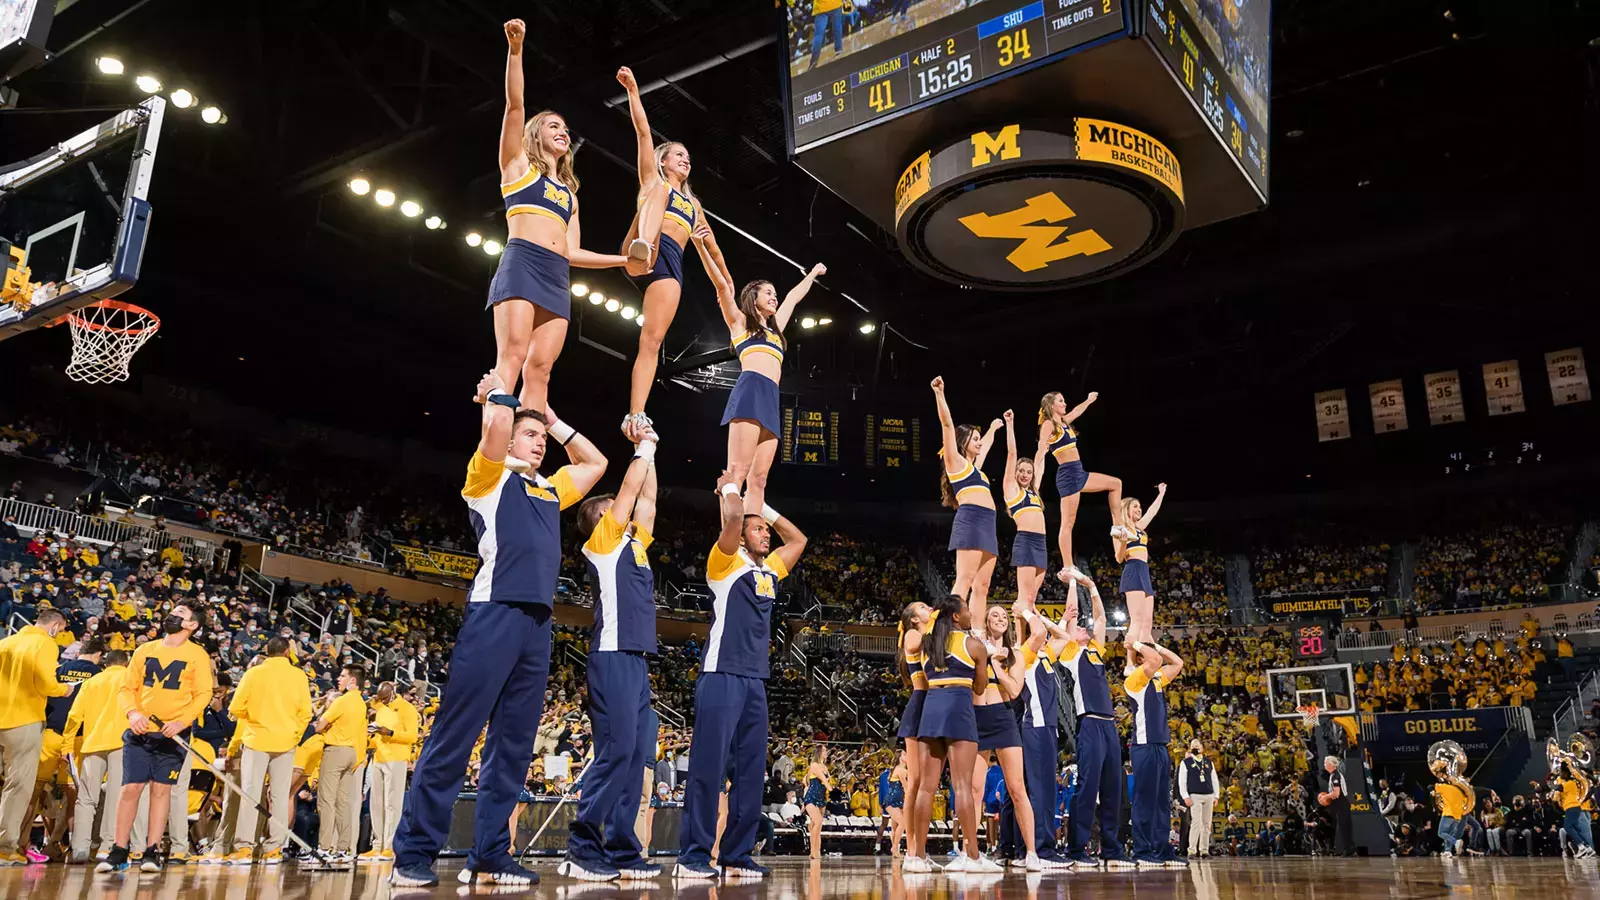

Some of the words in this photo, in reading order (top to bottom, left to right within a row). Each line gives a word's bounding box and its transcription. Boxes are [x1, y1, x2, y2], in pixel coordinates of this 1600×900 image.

[1003, 10, 1023, 28] SHU
[1052, 14, 1073, 31] TIME
[1074, 7, 1094, 23] OUTS
[920, 45, 942, 64] HALF
[947, 38, 955, 55] 2
[997, 28, 1032, 67] 34
[858, 57, 902, 84] MICHIGAN
[917, 54, 974, 99] 15:25
[1183, 51, 1195, 92] 41
[803, 91, 823, 106] FOULS
[832, 79, 847, 96] 02
[868, 79, 896, 113] 41
[798, 112, 815, 125] TIME
[814, 105, 832, 120] OUTS
[836, 98, 845, 112] 3
[1203, 83, 1225, 133] 15:25
[970, 124, 1021, 168] M
[1231, 120, 1243, 158] 34
[1089, 124, 1180, 181] MICHIGAN
[1111, 149, 1173, 186] BASKETBALL
[957, 191, 1114, 273] M
[1494, 376, 1510, 389] 41
[1558, 364, 1577, 378] 22
[1380, 395, 1397, 407] 45
[1436, 386, 1453, 399] 35
[1325, 404, 1340, 416] 33
[804, 451, 818, 462] M
[886, 456, 900, 467] M
[1273, 597, 1370, 614] @UMICHATHLICS
[1301, 637, 1323, 655] 20
[67, 670, 92, 678] STAND
[143, 656, 188, 691] M
[1404, 720, 1427, 734] GO
[1429, 717, 1477, 733] BLUE
